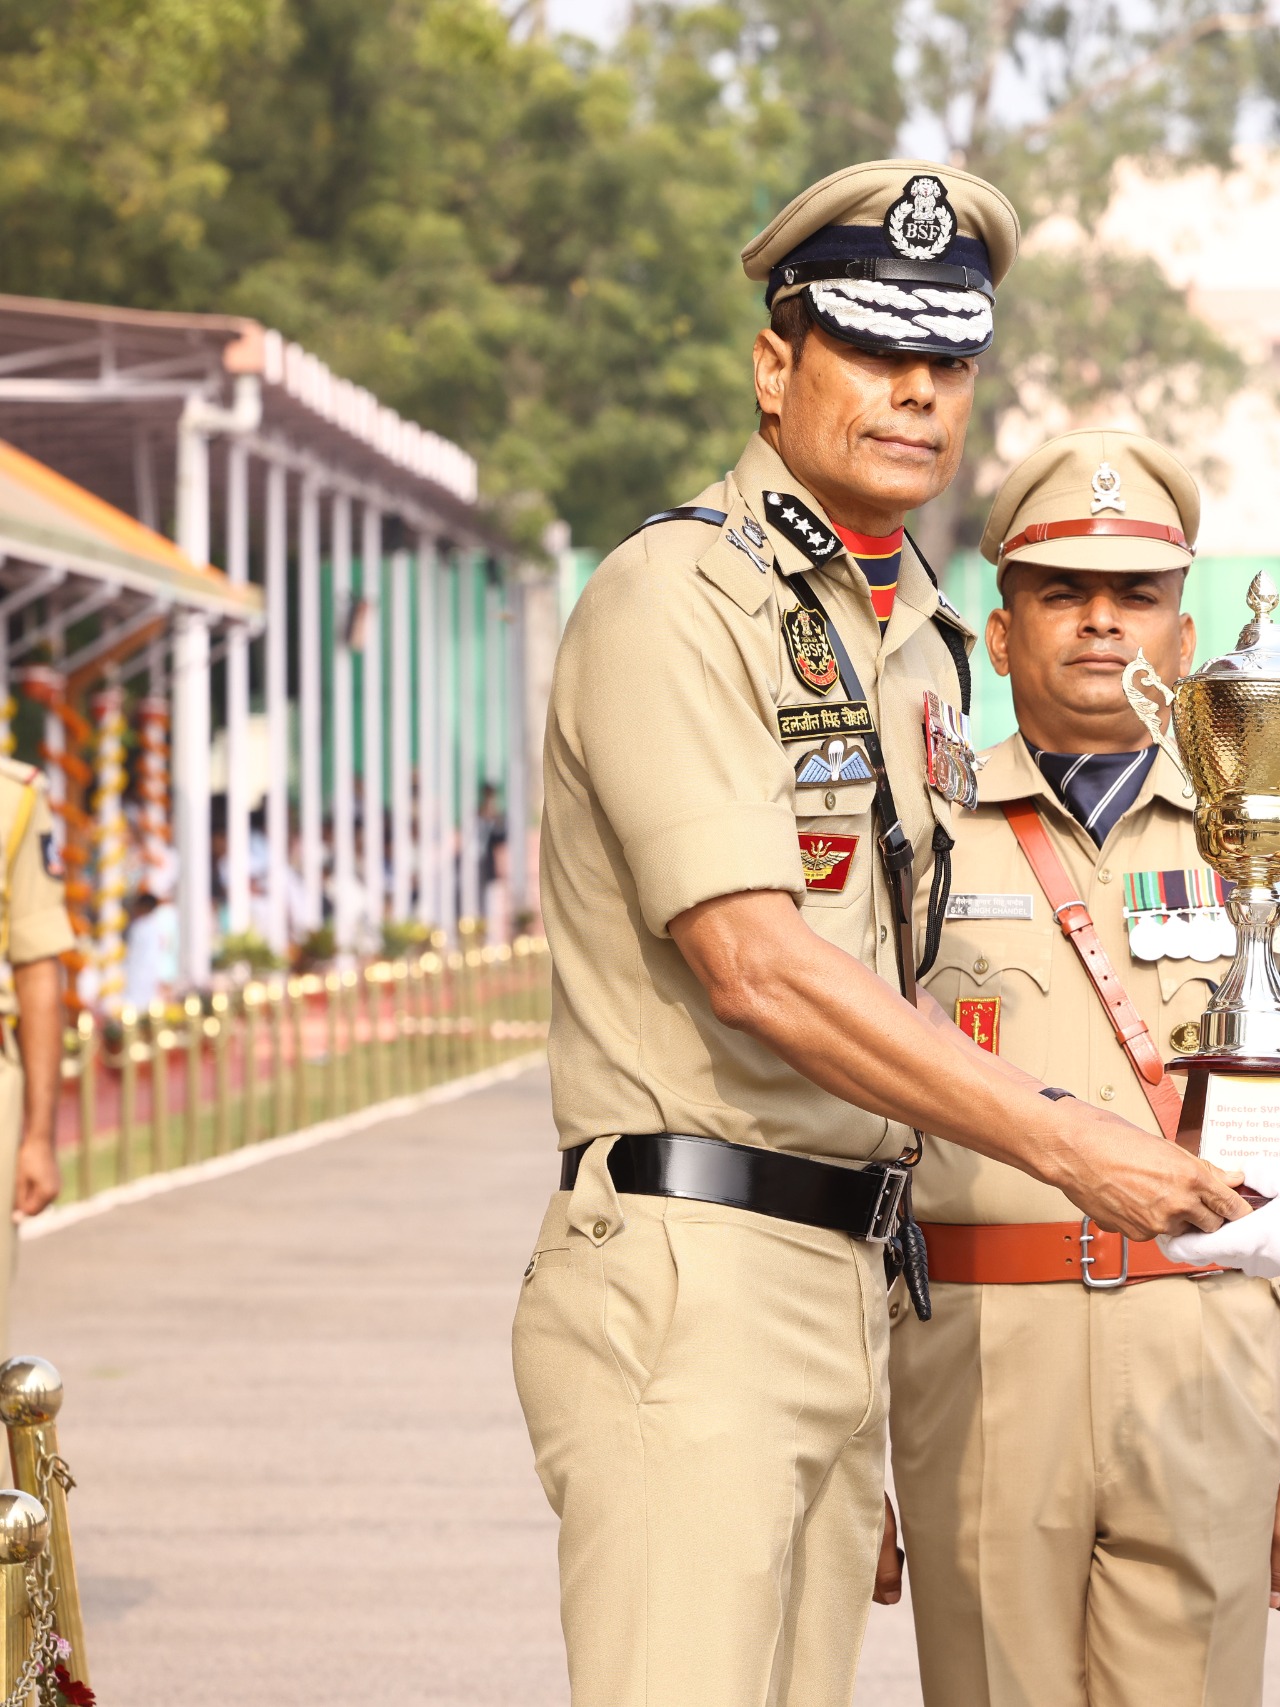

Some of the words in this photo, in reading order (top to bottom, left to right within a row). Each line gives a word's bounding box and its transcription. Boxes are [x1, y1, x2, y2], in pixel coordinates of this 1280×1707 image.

[905, 222, 941, 241] BSF
[802, 643, 823, 657] BSF
[967, 907, 991, 915] SINGH
[992, 907, 1028, 915] CHANDEL
[1216, 1104, 1258, 1113] Director
[1260, 1105, 1280, 1114] SVP
[1209, 1119, 1243, 1129] Trophy
[1246, 1119, 1260, 1128] for
[1219, 1148, 1260, 1157] Outdoor
